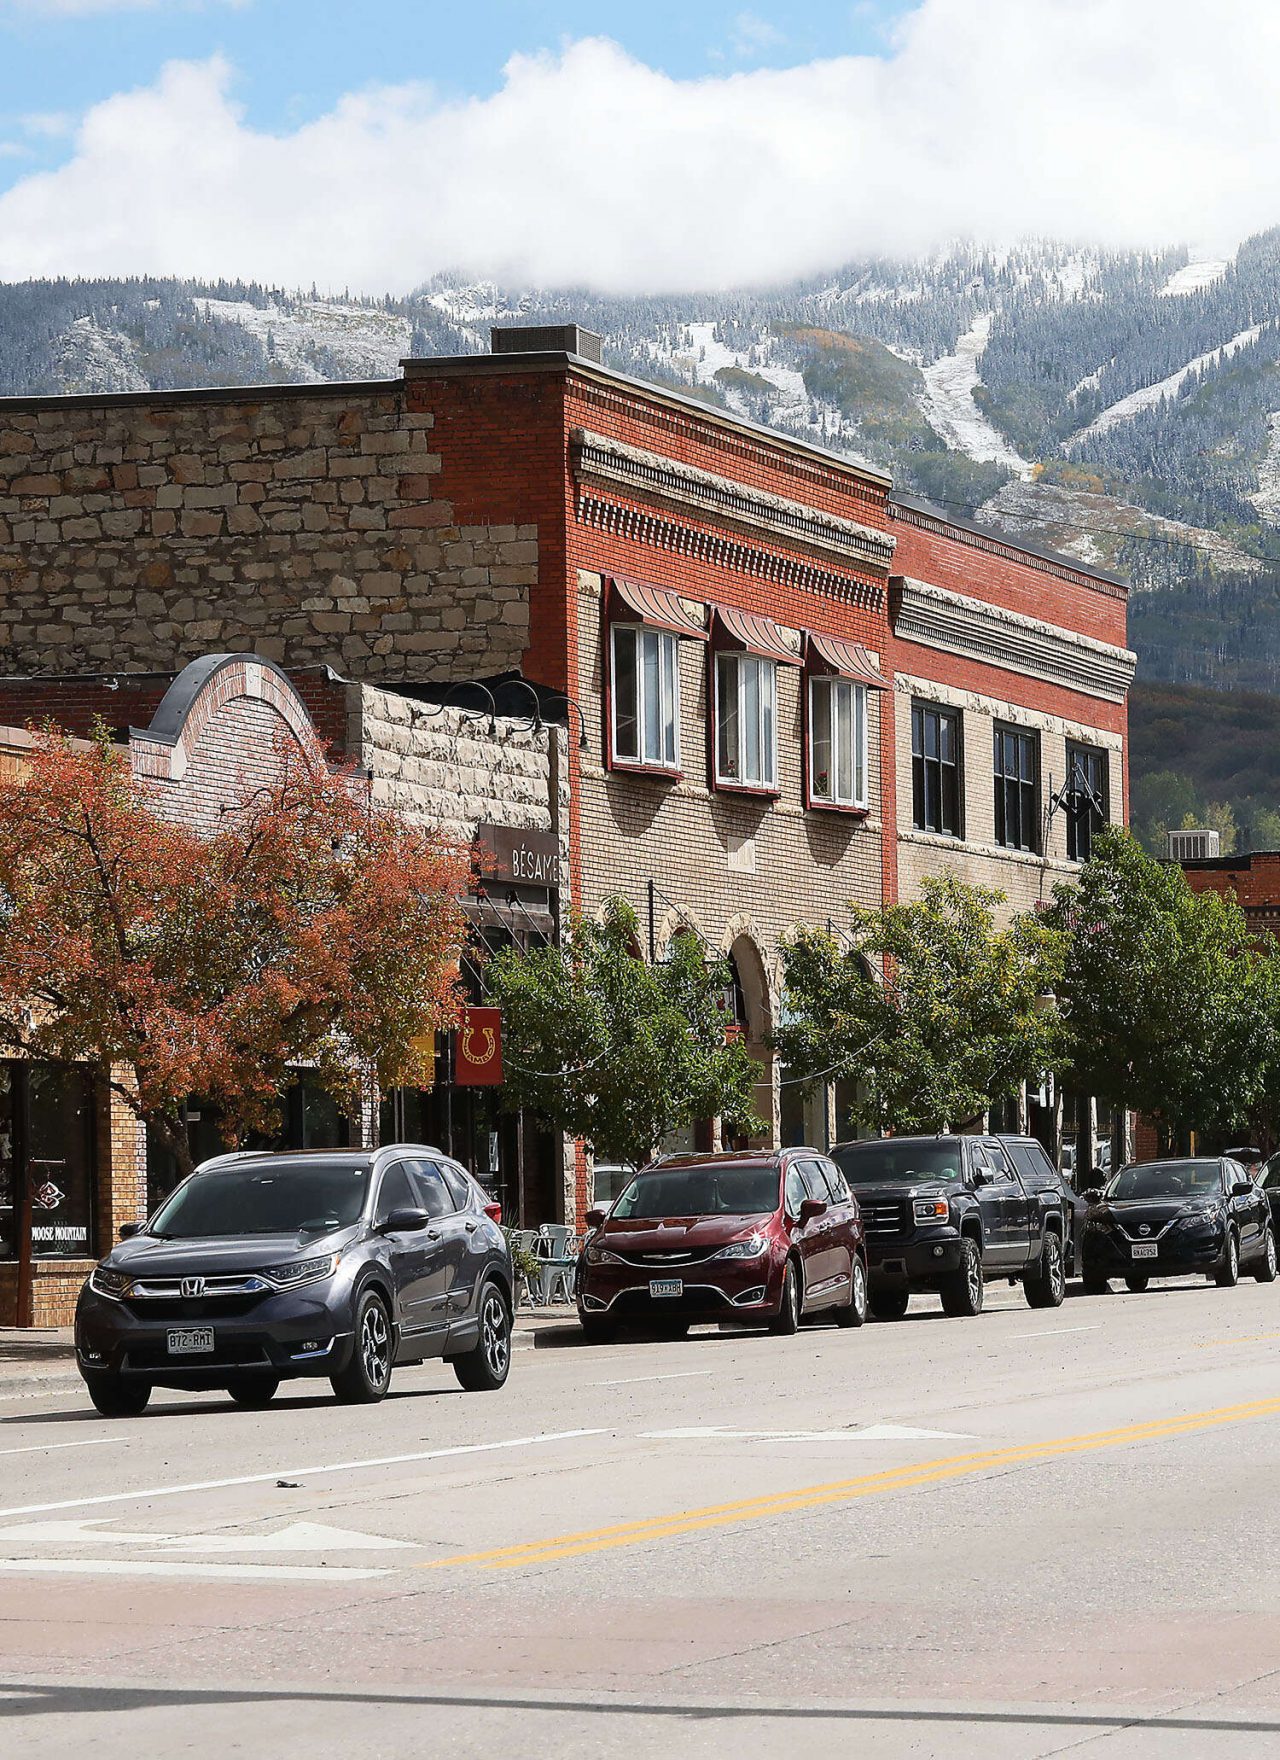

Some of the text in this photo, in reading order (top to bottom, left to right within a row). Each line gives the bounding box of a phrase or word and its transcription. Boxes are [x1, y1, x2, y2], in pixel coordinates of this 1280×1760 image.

[462, 1029, 495, 1064] TEAMBOAT
[32, 1226, 87, 1241] MOOSE MOUNTAIN
